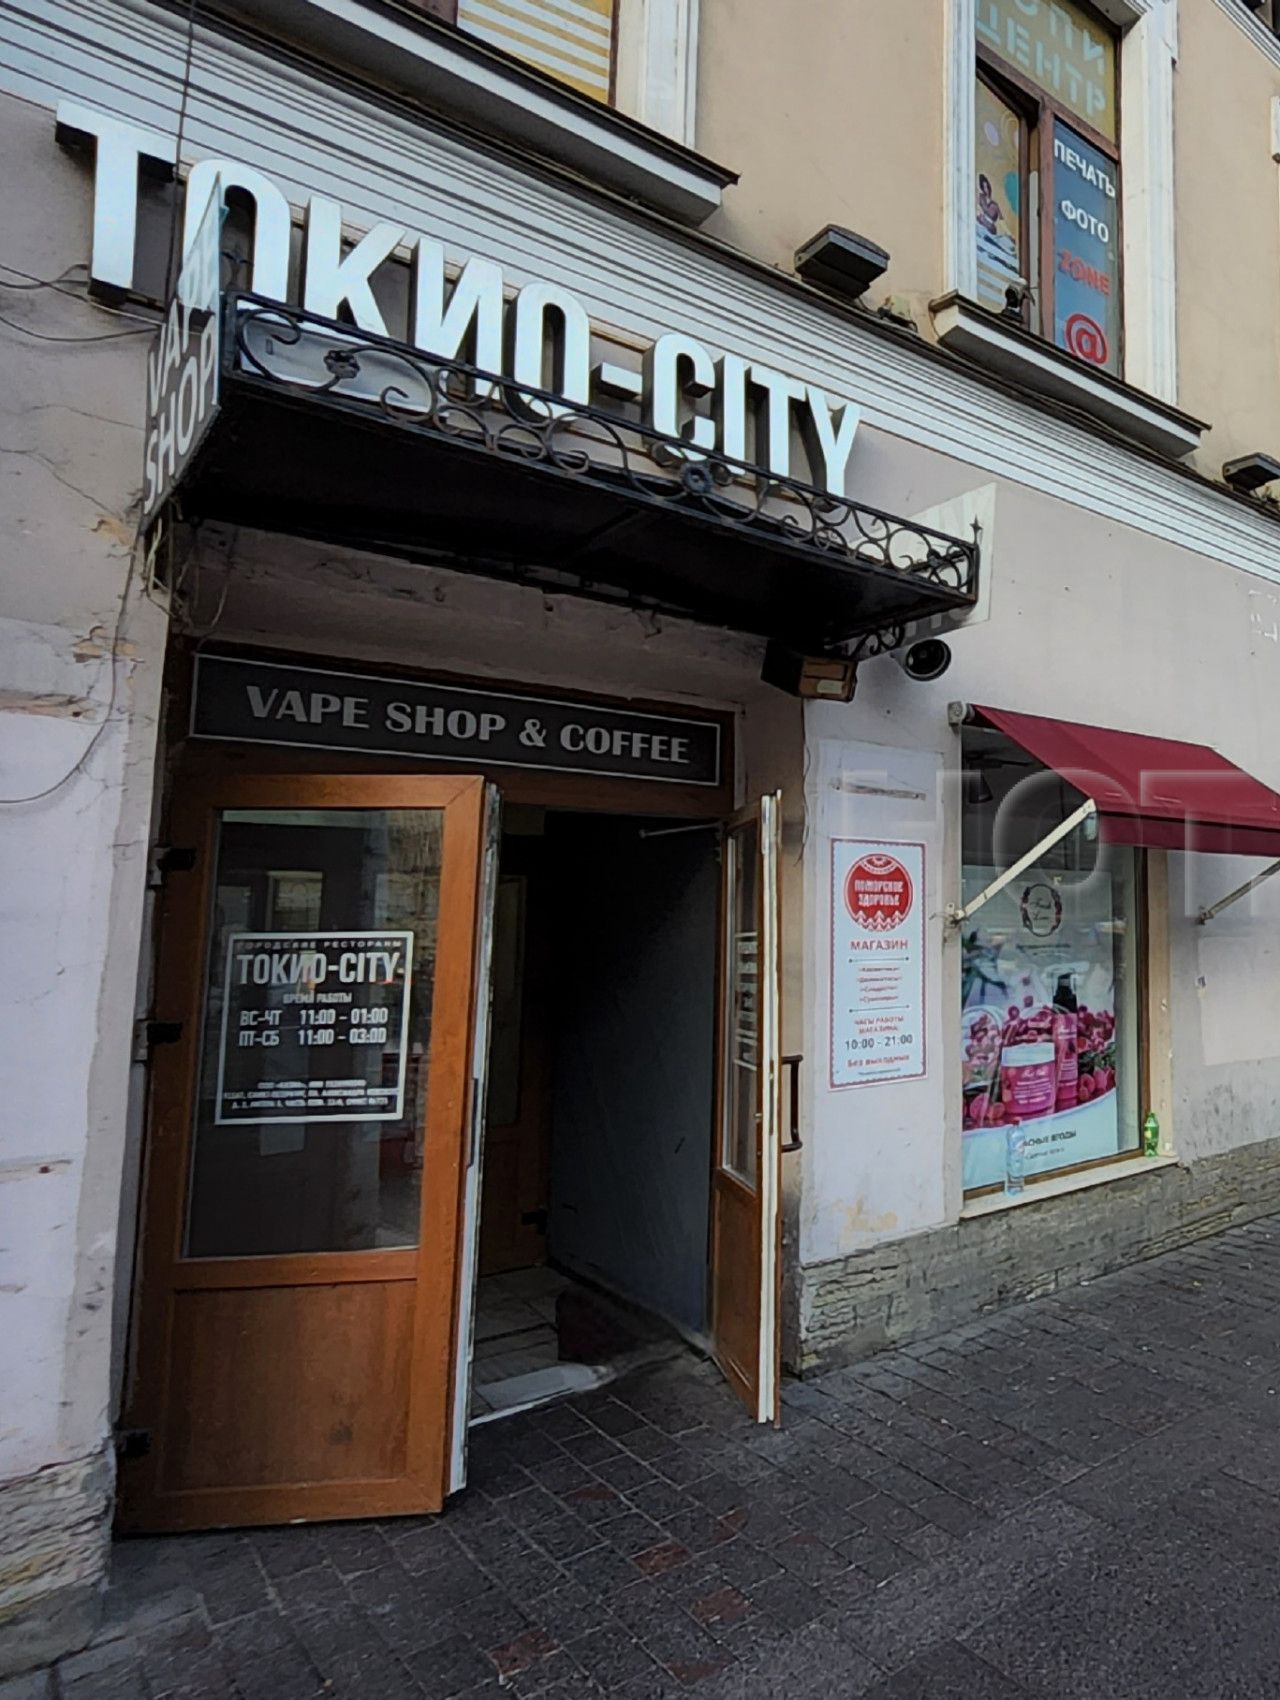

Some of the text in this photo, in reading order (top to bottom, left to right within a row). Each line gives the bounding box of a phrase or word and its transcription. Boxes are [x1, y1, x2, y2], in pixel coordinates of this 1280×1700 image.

[975, 0, 1106, 117] ЦЕНТР
[1053, 138, 1116, 198] ПЕЧАТЬ
[1060, 199, 1109, 243] ФОТО
[144, 312, 217, 515] SHOP
[246, 685, 691, 765] VAPE SHOP & COFFEE
[850, 939, 909, 951] МАГАЗИН
[298, 1029, 335, 1045] 11:00
[349, 1026, 387, 1044] 03:00
[300, 1007, 336, 1025] 11:00
[350, 1007, 389, 1025] 01:00
[845, 1037, 875, 1051] 10:00
[884, 1033, 914, 1047] 21:00
